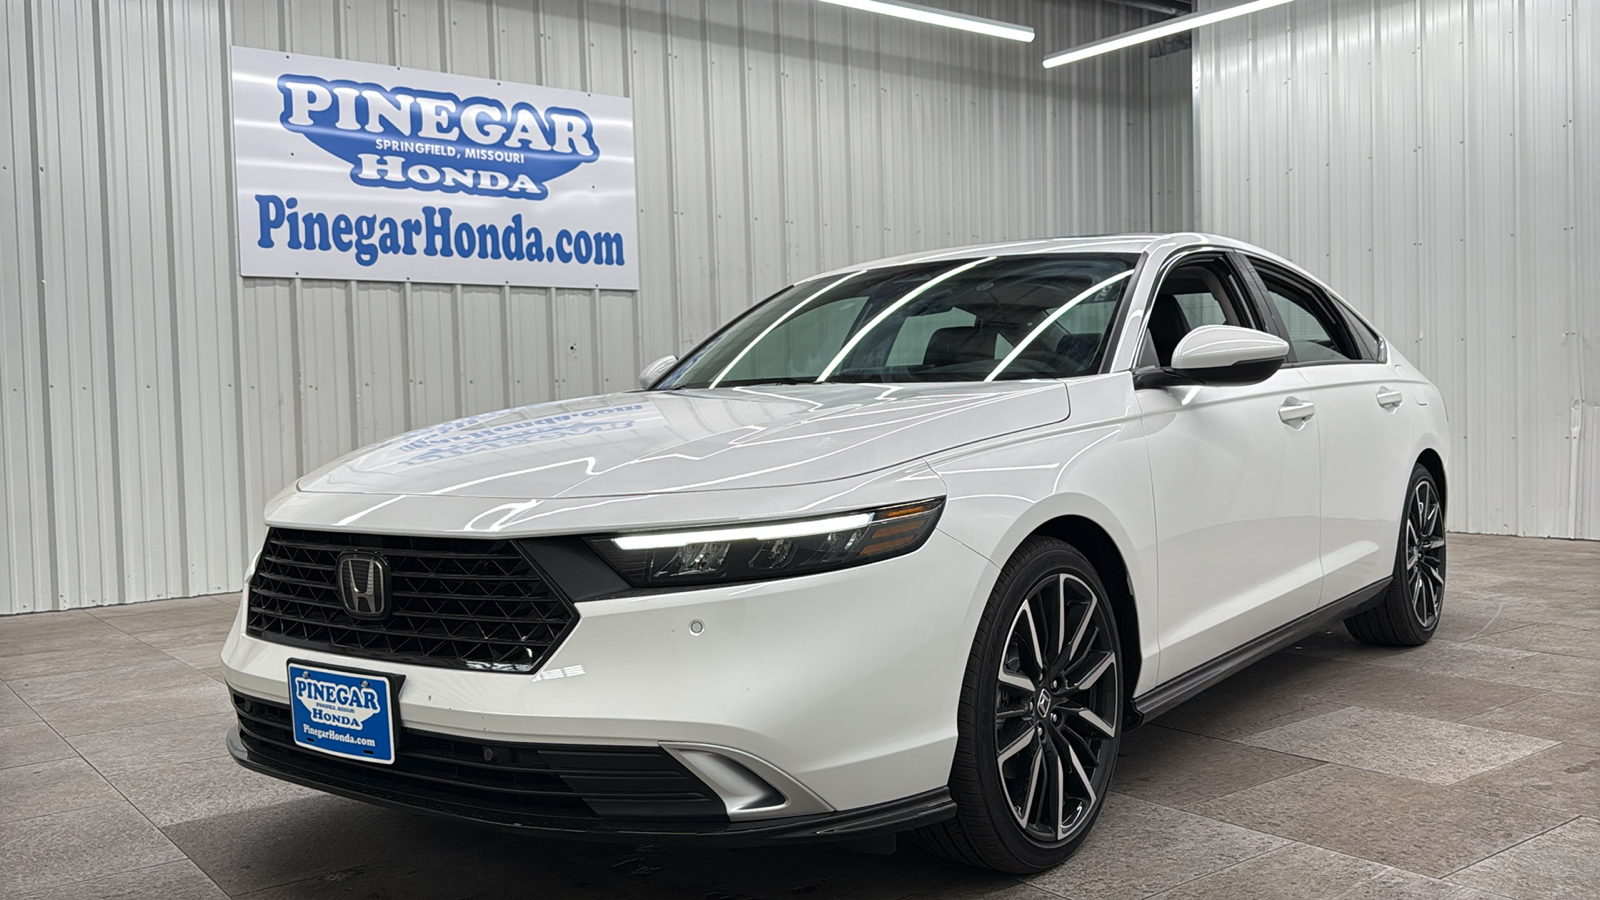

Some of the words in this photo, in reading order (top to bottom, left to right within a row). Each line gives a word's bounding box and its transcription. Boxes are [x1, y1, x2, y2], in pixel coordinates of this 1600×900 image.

[285, 82, 594, 156] PINEGAR
[375, 138, 461, 160] SPRINGFIELD,
[464, 148, 525, 164] MISSOURI
[359, 153, 541, 194] HONDA
[255, 194, 625, 267] PinegarHonda.com
[297, 680, 378, 710] PINEGAR
[312, 708, 361, 727] HONDA
[303, 723, 376, 747] PinegarHonda.com
